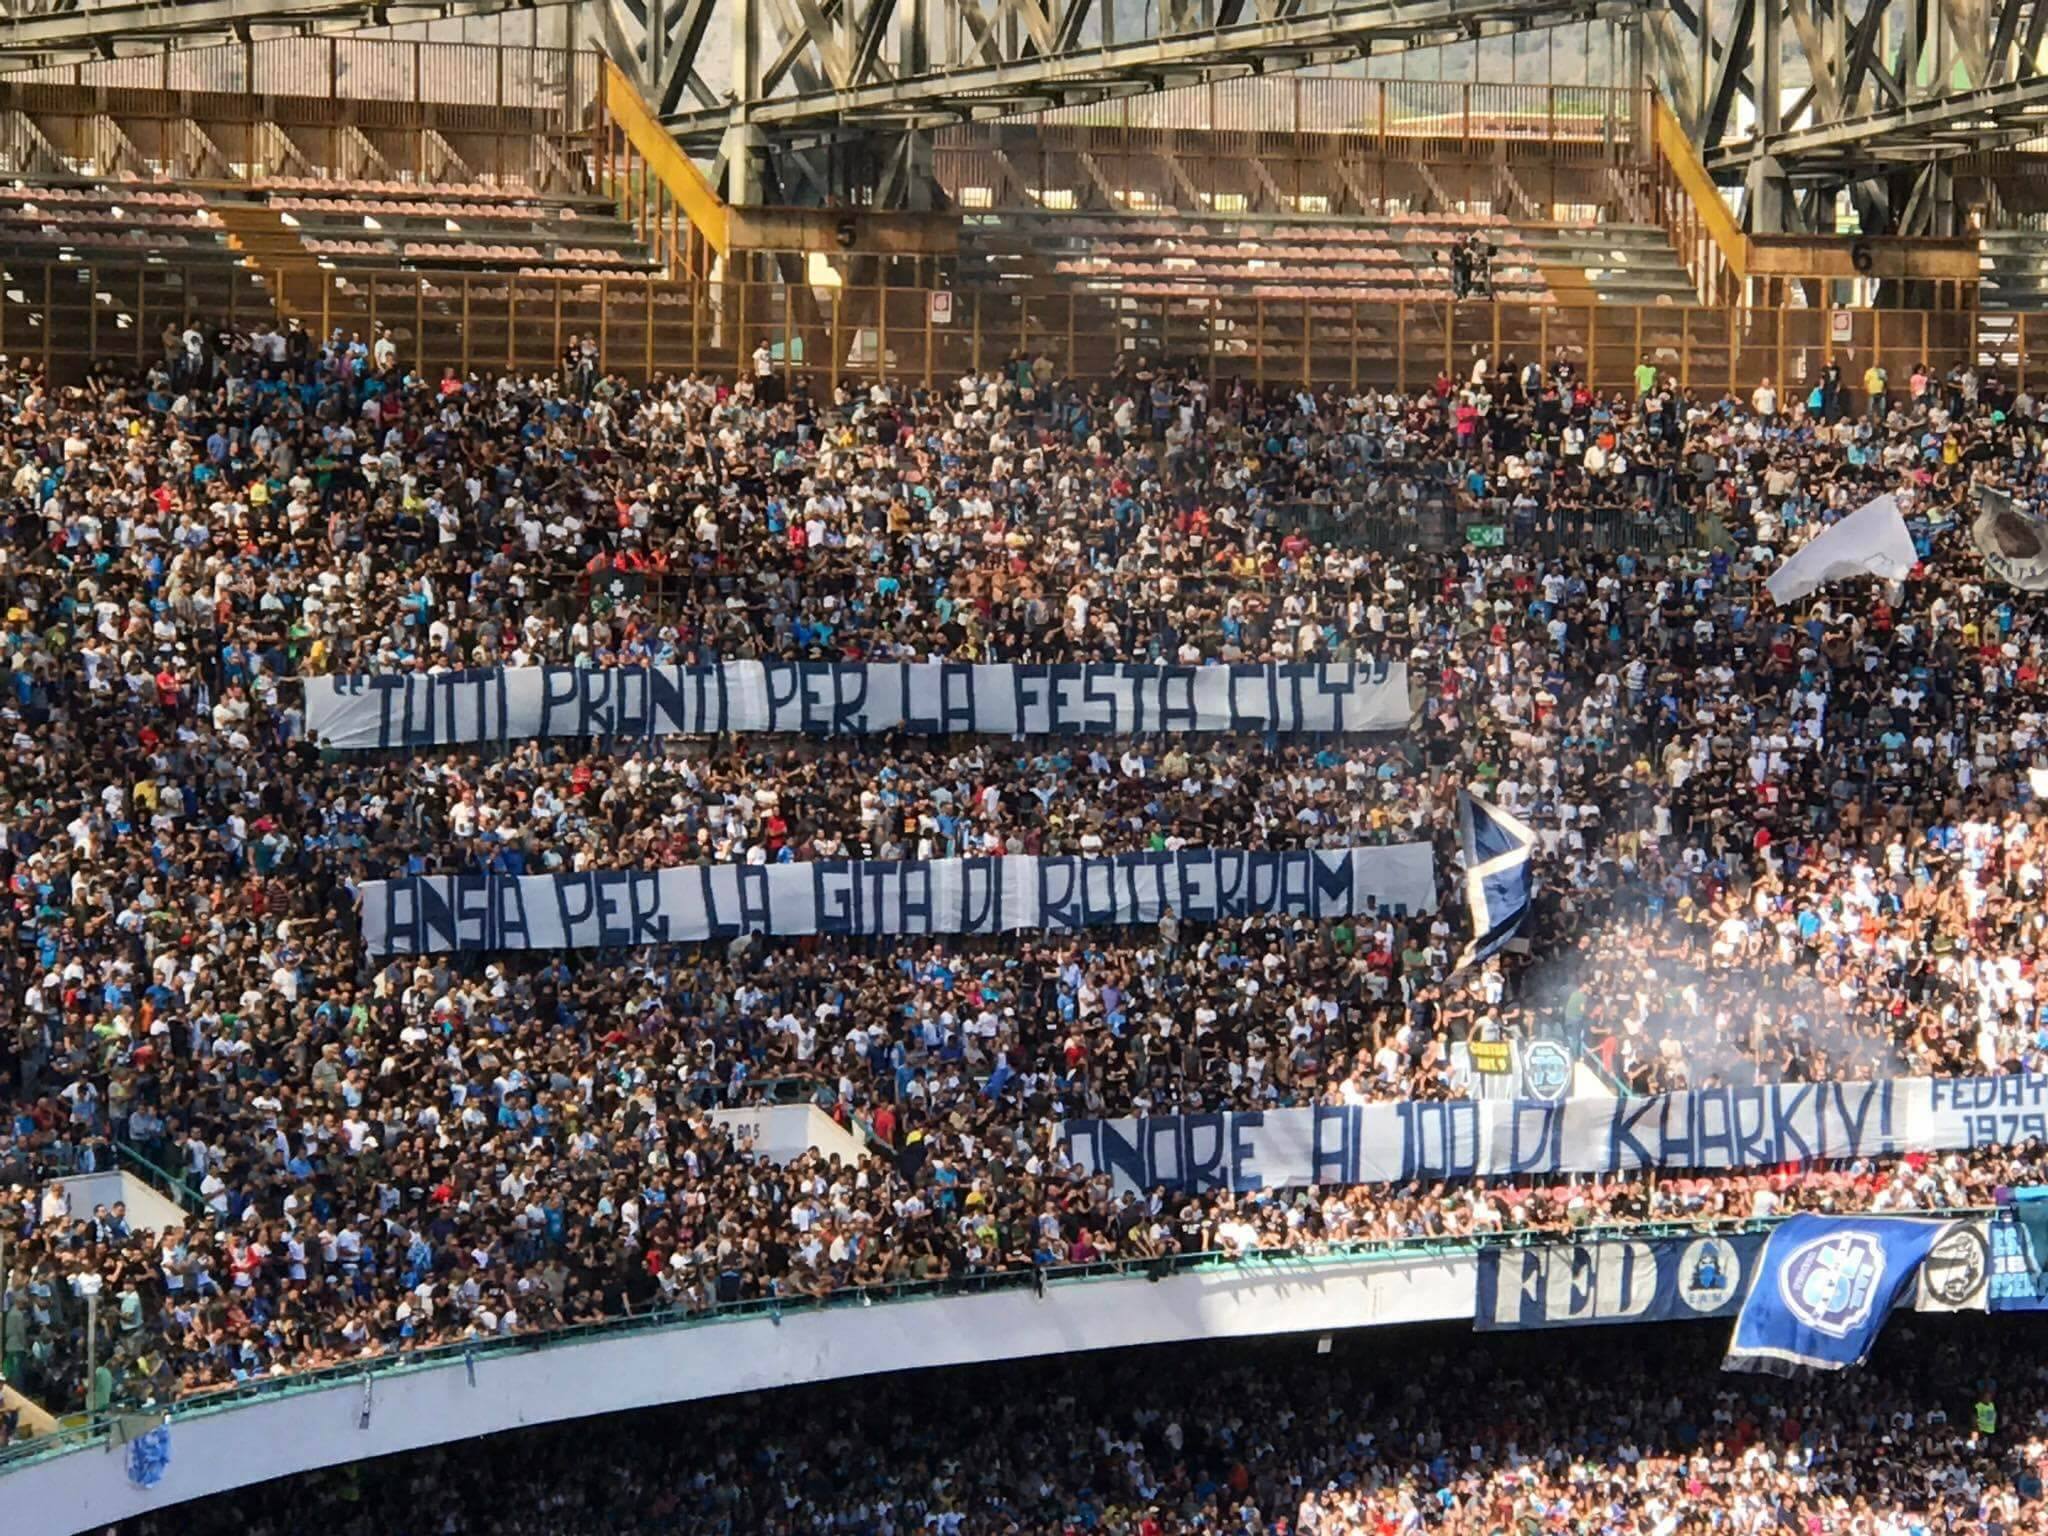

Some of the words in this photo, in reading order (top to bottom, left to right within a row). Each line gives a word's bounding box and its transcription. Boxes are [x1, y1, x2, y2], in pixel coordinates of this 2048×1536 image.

[539, 662, 728, 738] PRONTI
[763, 660, 868, 736] PER
[901, 663, 976, 735] LA
[1013, 663, 1197, 735] FESTA
[384, 873, 531, 955] ANSIA
[552, 868, 670, 949] PER
[701, 862, 772, 937] LA
[812, 857, 933, 935] GITA
[961, 855, 1002, 934] DI
[1064, 1111, 1264, 1198] ONORE
[1313, 1103, 1363, 1186] AI
[1398, 1100, 1479, 1181] 100
[1512, 1098, 1566, 1176] DI
[1963, 1113, 2046, 1150] 1979
[1495, 1242, 1658, 1323] FED
